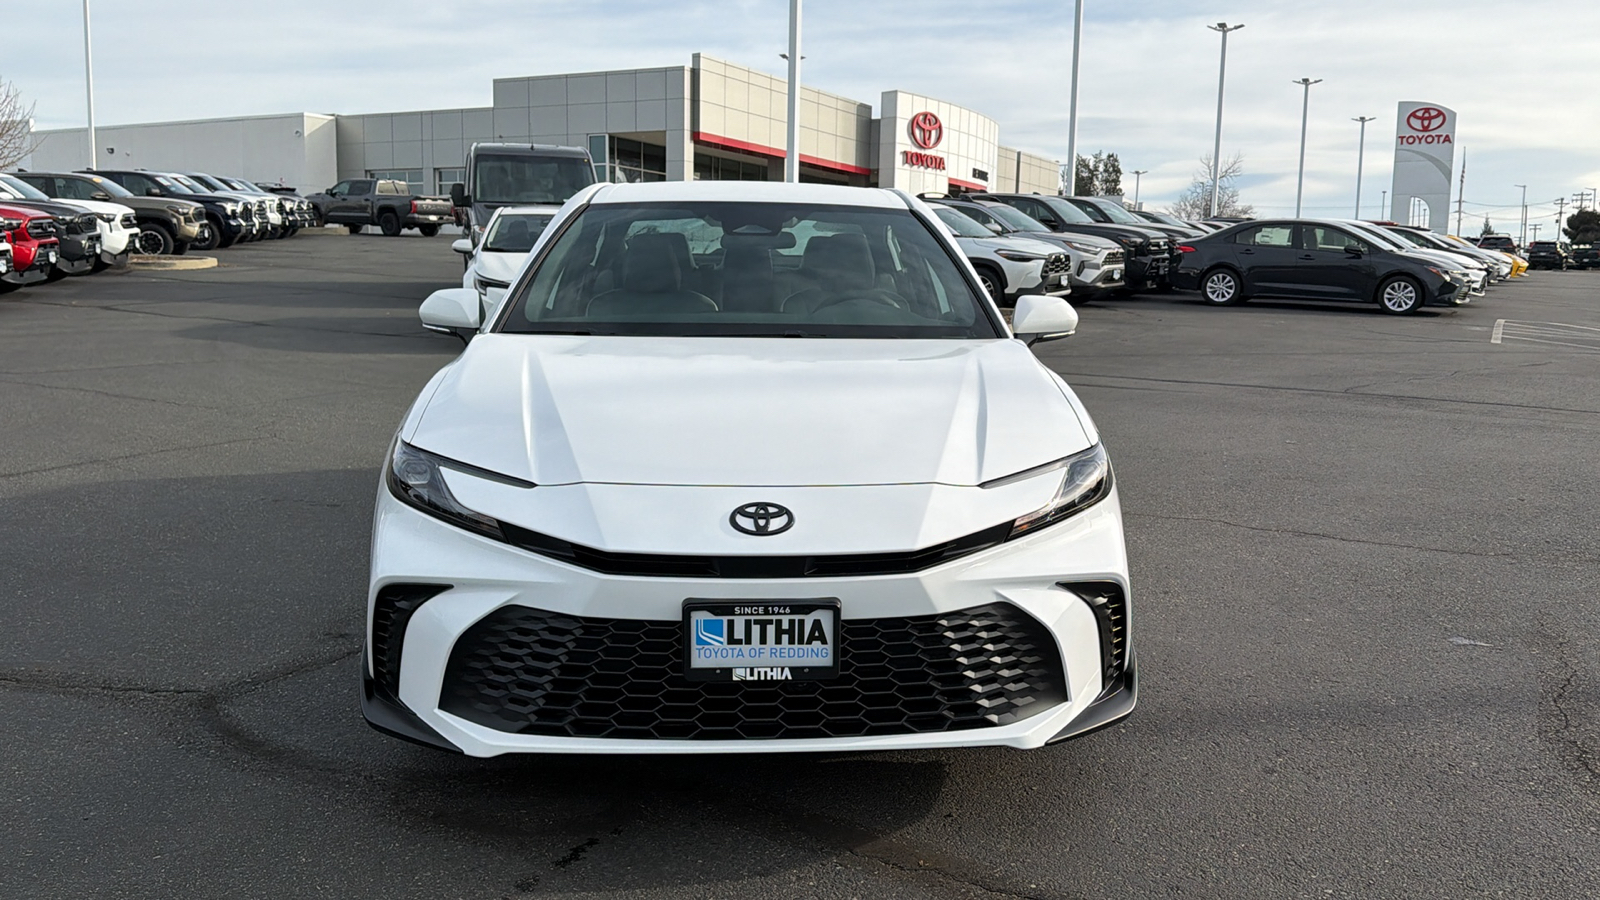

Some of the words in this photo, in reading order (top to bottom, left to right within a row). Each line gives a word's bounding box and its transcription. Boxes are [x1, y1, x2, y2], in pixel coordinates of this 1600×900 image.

[1398, 134, 1452, 145] TOYOTA
[902, 150, 946, 171] TOYOTA
[734, 606, 765, 615] SINCE
[768, 606, 791, 614] 1946
[727, 619, 828, 646] LITHIA
[695, 647, 745, 659] TOYOTA
[748, 647, 766, 659] OF
[769, 647, 829, 659] REDDING
[745, 667, 793, 681] LITHIA
